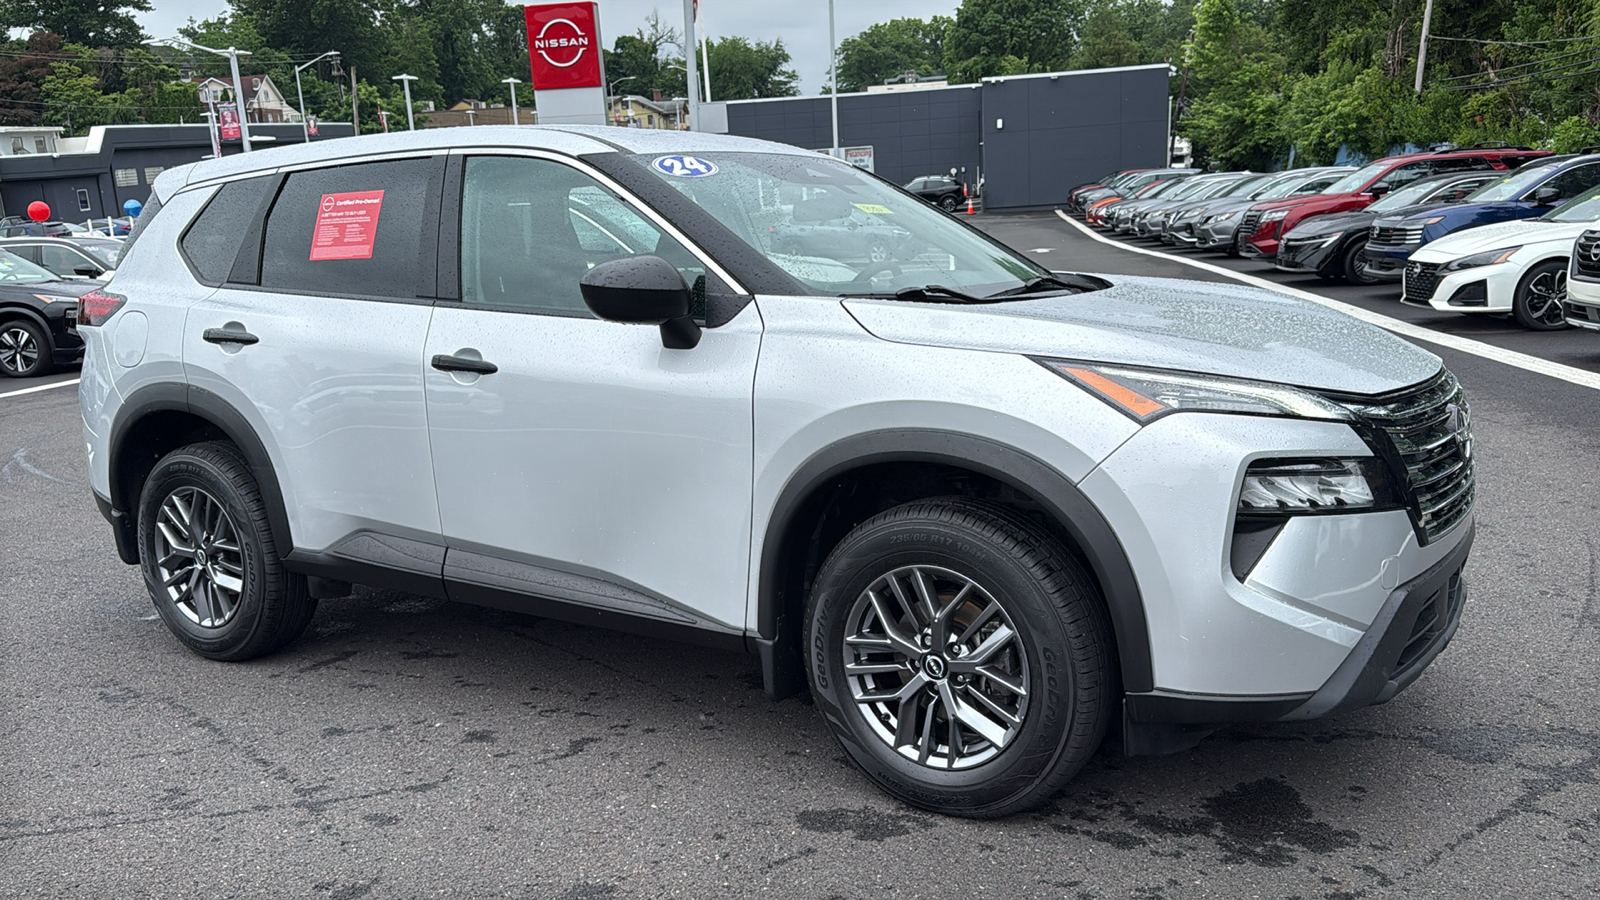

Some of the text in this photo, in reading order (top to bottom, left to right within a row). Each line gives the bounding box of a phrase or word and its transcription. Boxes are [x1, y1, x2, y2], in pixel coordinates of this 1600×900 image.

[535, 37, 588, 49] NISSAN
[846, 150, 872, 158] Financing
[663, 157, 709, 175] 24
[890, 533, 927, 544] 235/65
[930, 535, 953, 546] R17
[815, 599, 832, 690] GeoDrive
